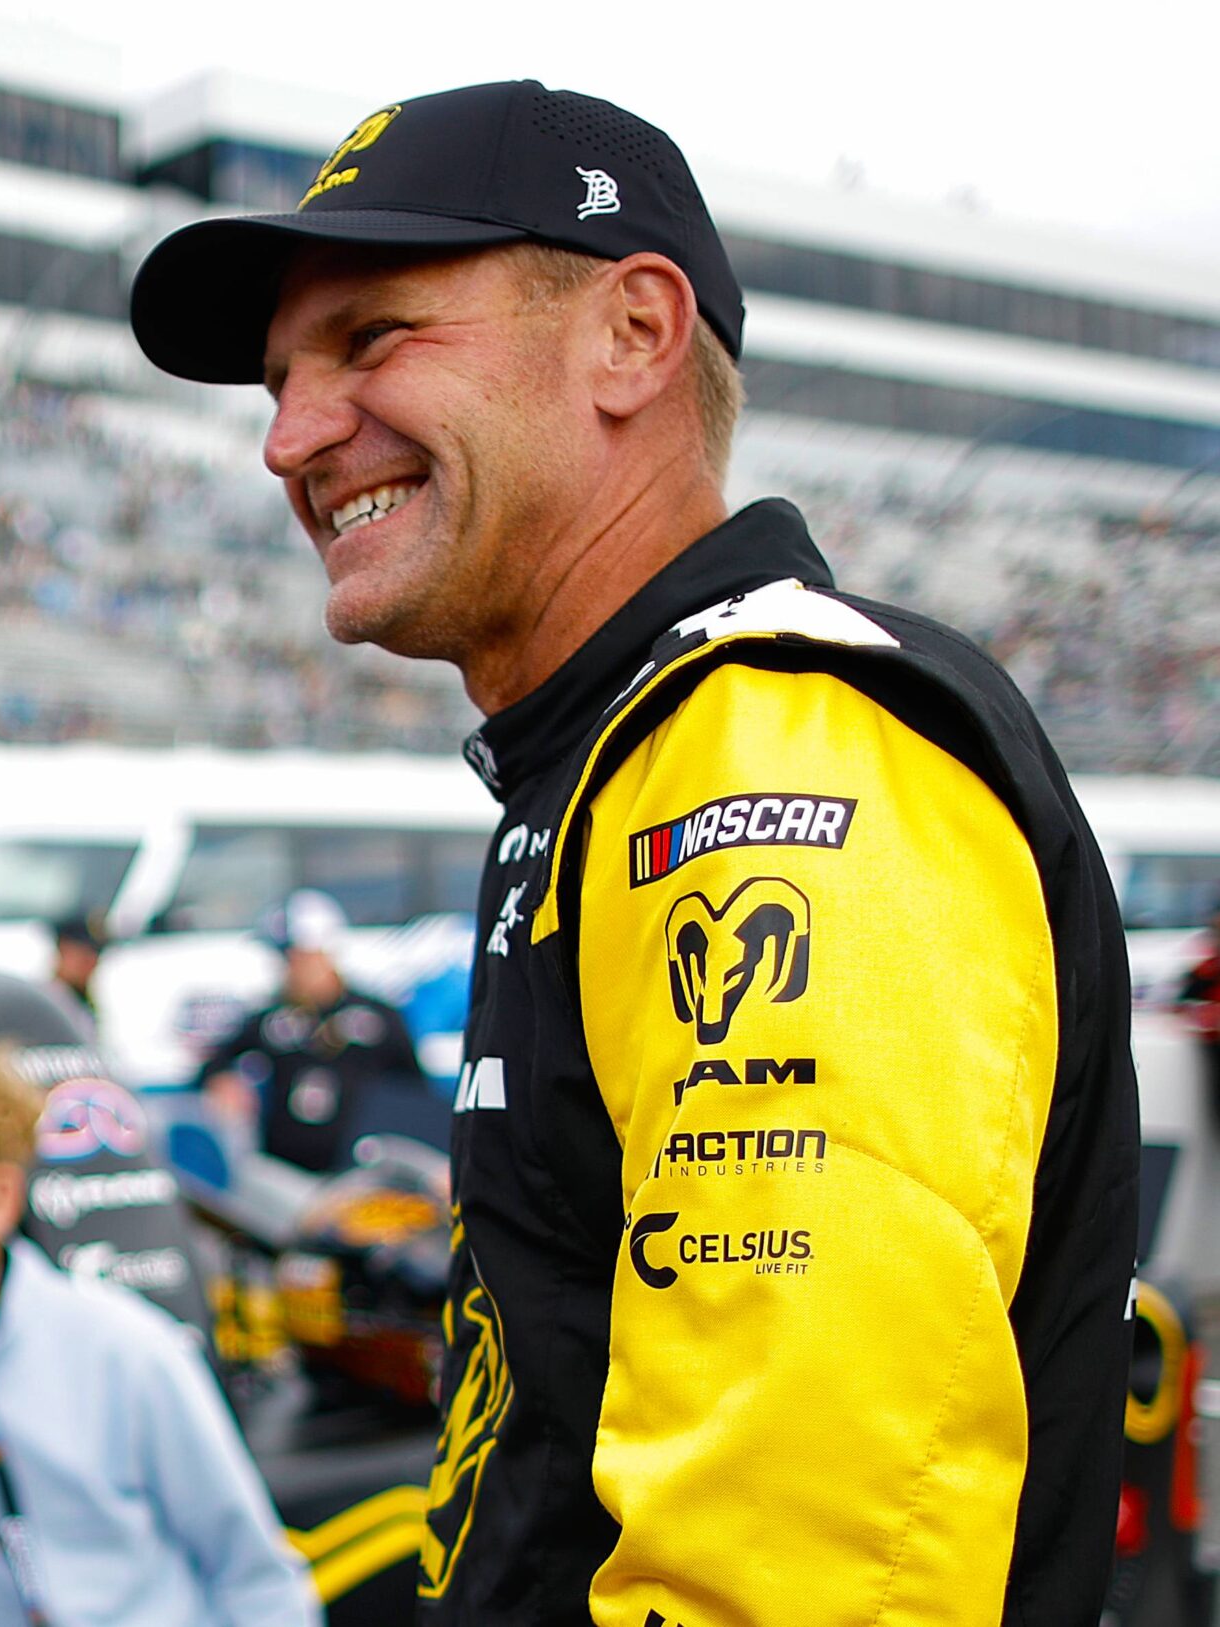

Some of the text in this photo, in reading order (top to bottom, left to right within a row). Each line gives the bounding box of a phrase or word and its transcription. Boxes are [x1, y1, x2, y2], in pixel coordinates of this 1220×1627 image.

[678, 798, 846, 863] NASCAR
[665, 1129, 827, 1162] ACTION
[669, 1162, 824, 1178] INDUSTRIES
[755, 1263, 808, 1275] LIVE FIT
